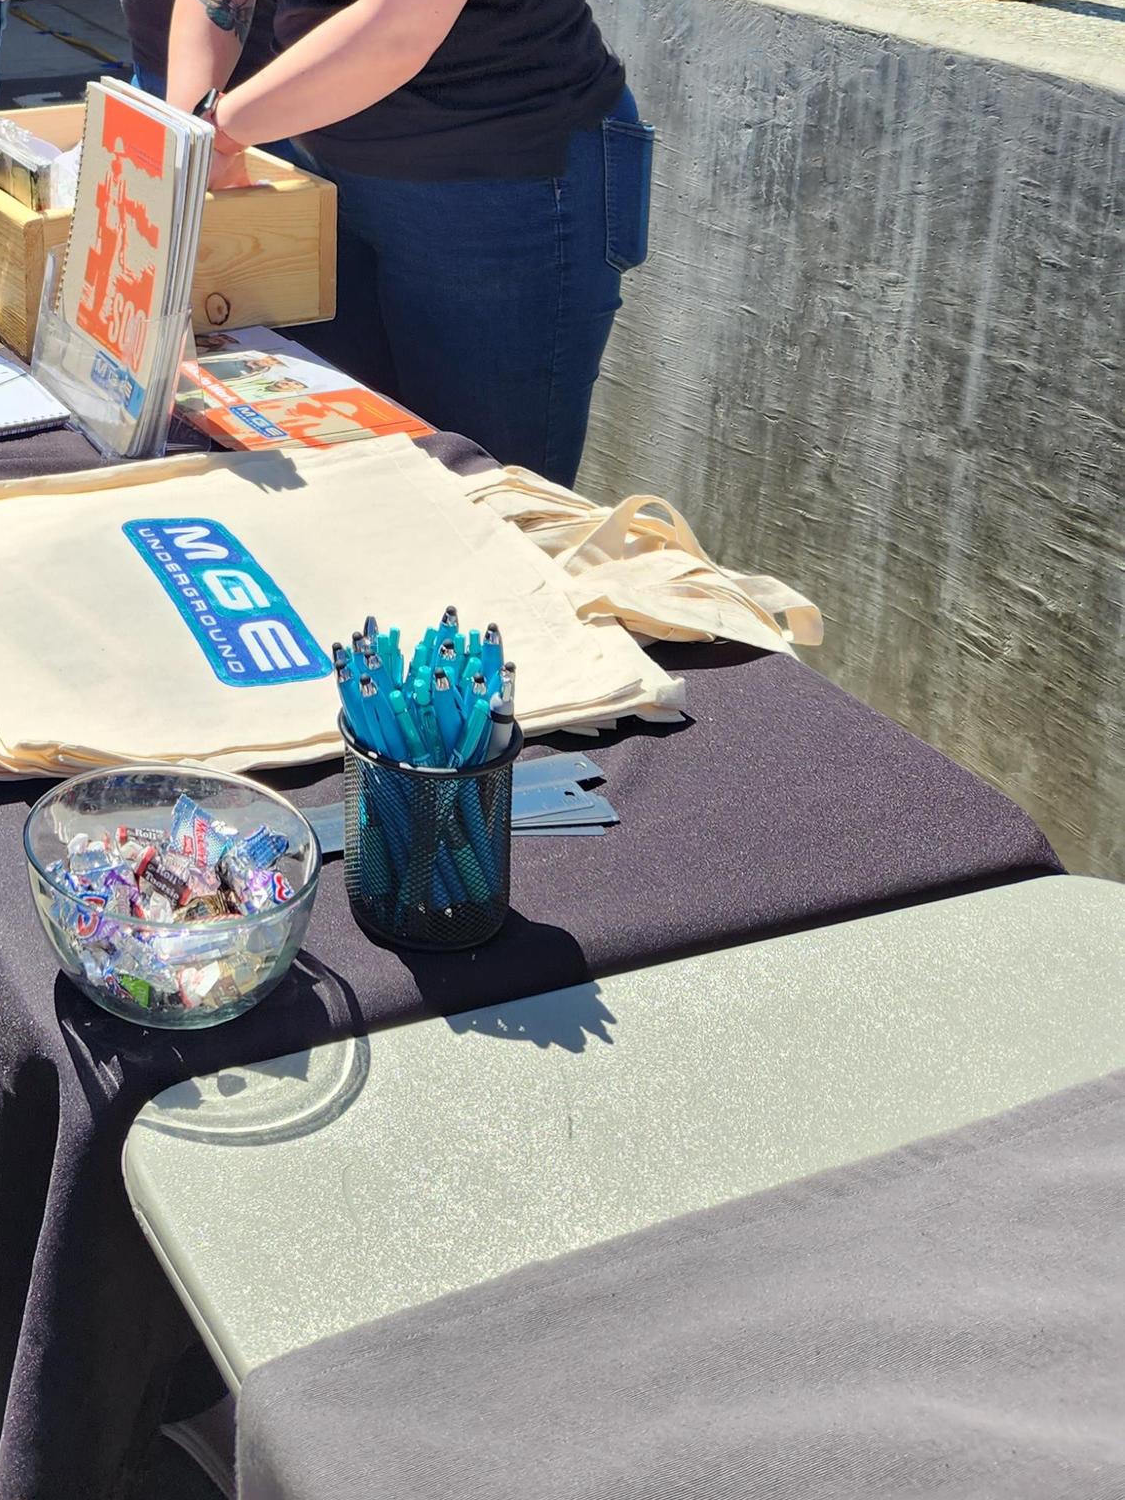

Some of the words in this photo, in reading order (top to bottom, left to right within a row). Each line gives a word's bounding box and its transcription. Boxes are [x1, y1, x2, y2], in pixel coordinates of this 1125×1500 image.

[239, 405, 283, 437] MGE
[138, 527, 246, 674] UNDERGROUND
[163, 525, 311, 673] MGE
[144, 870, 181, 900] Tootsie
